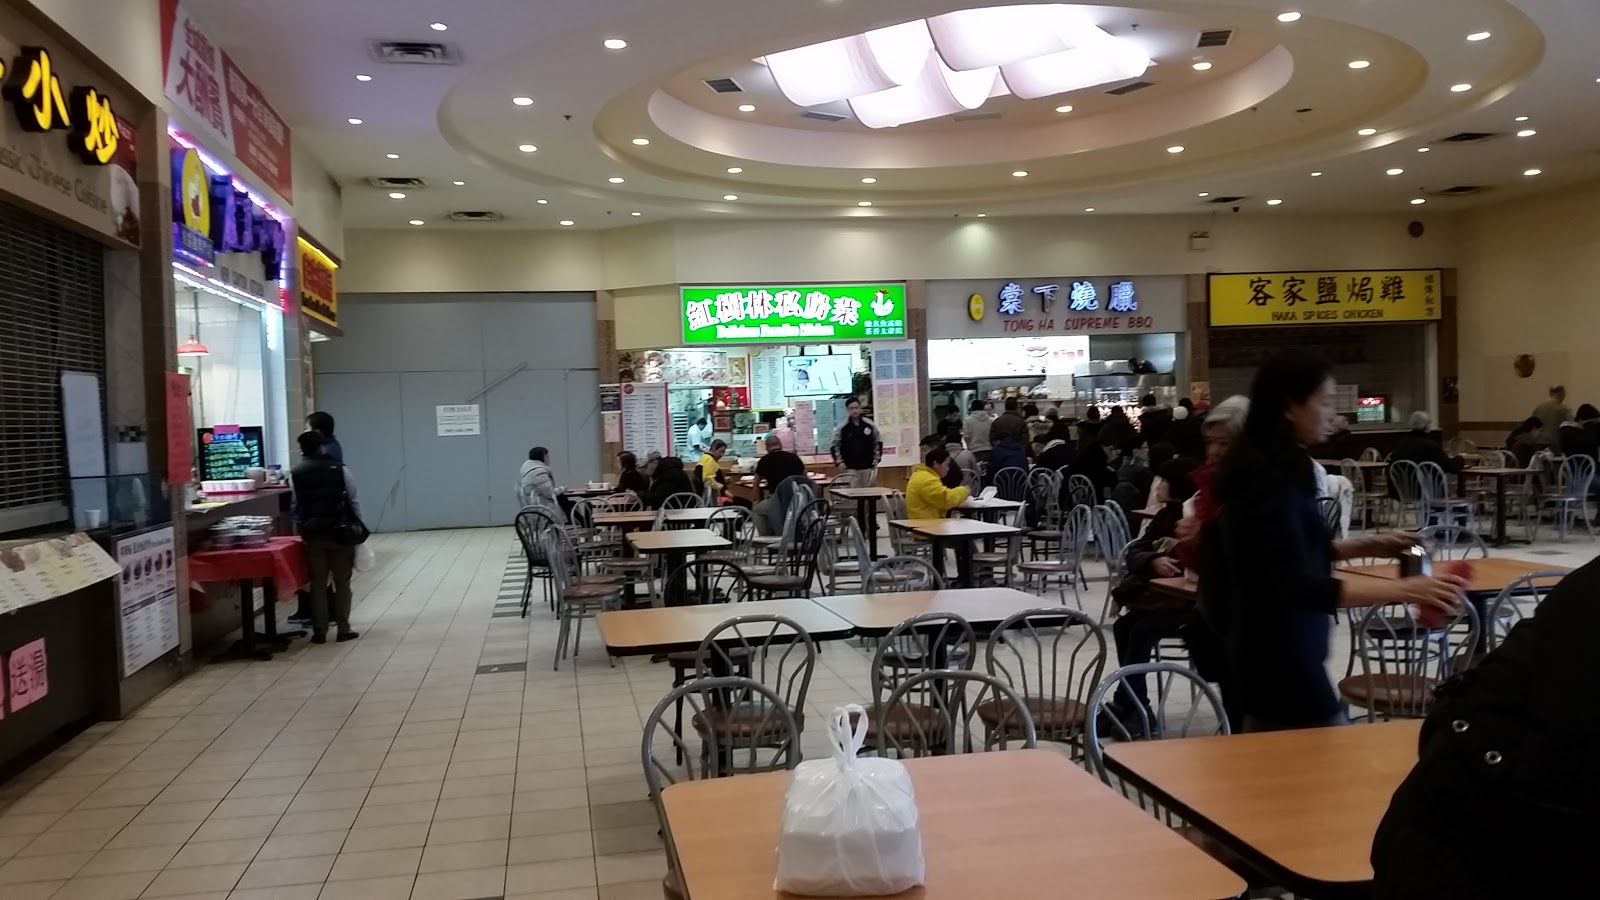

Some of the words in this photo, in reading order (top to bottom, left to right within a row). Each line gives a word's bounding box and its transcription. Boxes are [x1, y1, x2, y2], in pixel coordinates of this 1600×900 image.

[0, 49, 119, 164] 小炒
[998, 281, 1138, 314] 棠下燒臘
[1247, 276, 1406, 306] 客家鹽焗雞
[1003, 320, 1034, 332] TONG
[1038, 319, 1054, 331] HA
[1064, 317, 1120, 331] SUPREME
[1127, 316, 1153, 329] BBQ
[1272, 311, 1298, 321] HAKA
[1303, 310, 1338, 320] SPICES
[1343, 309, 1384, 319] CHICKEN
